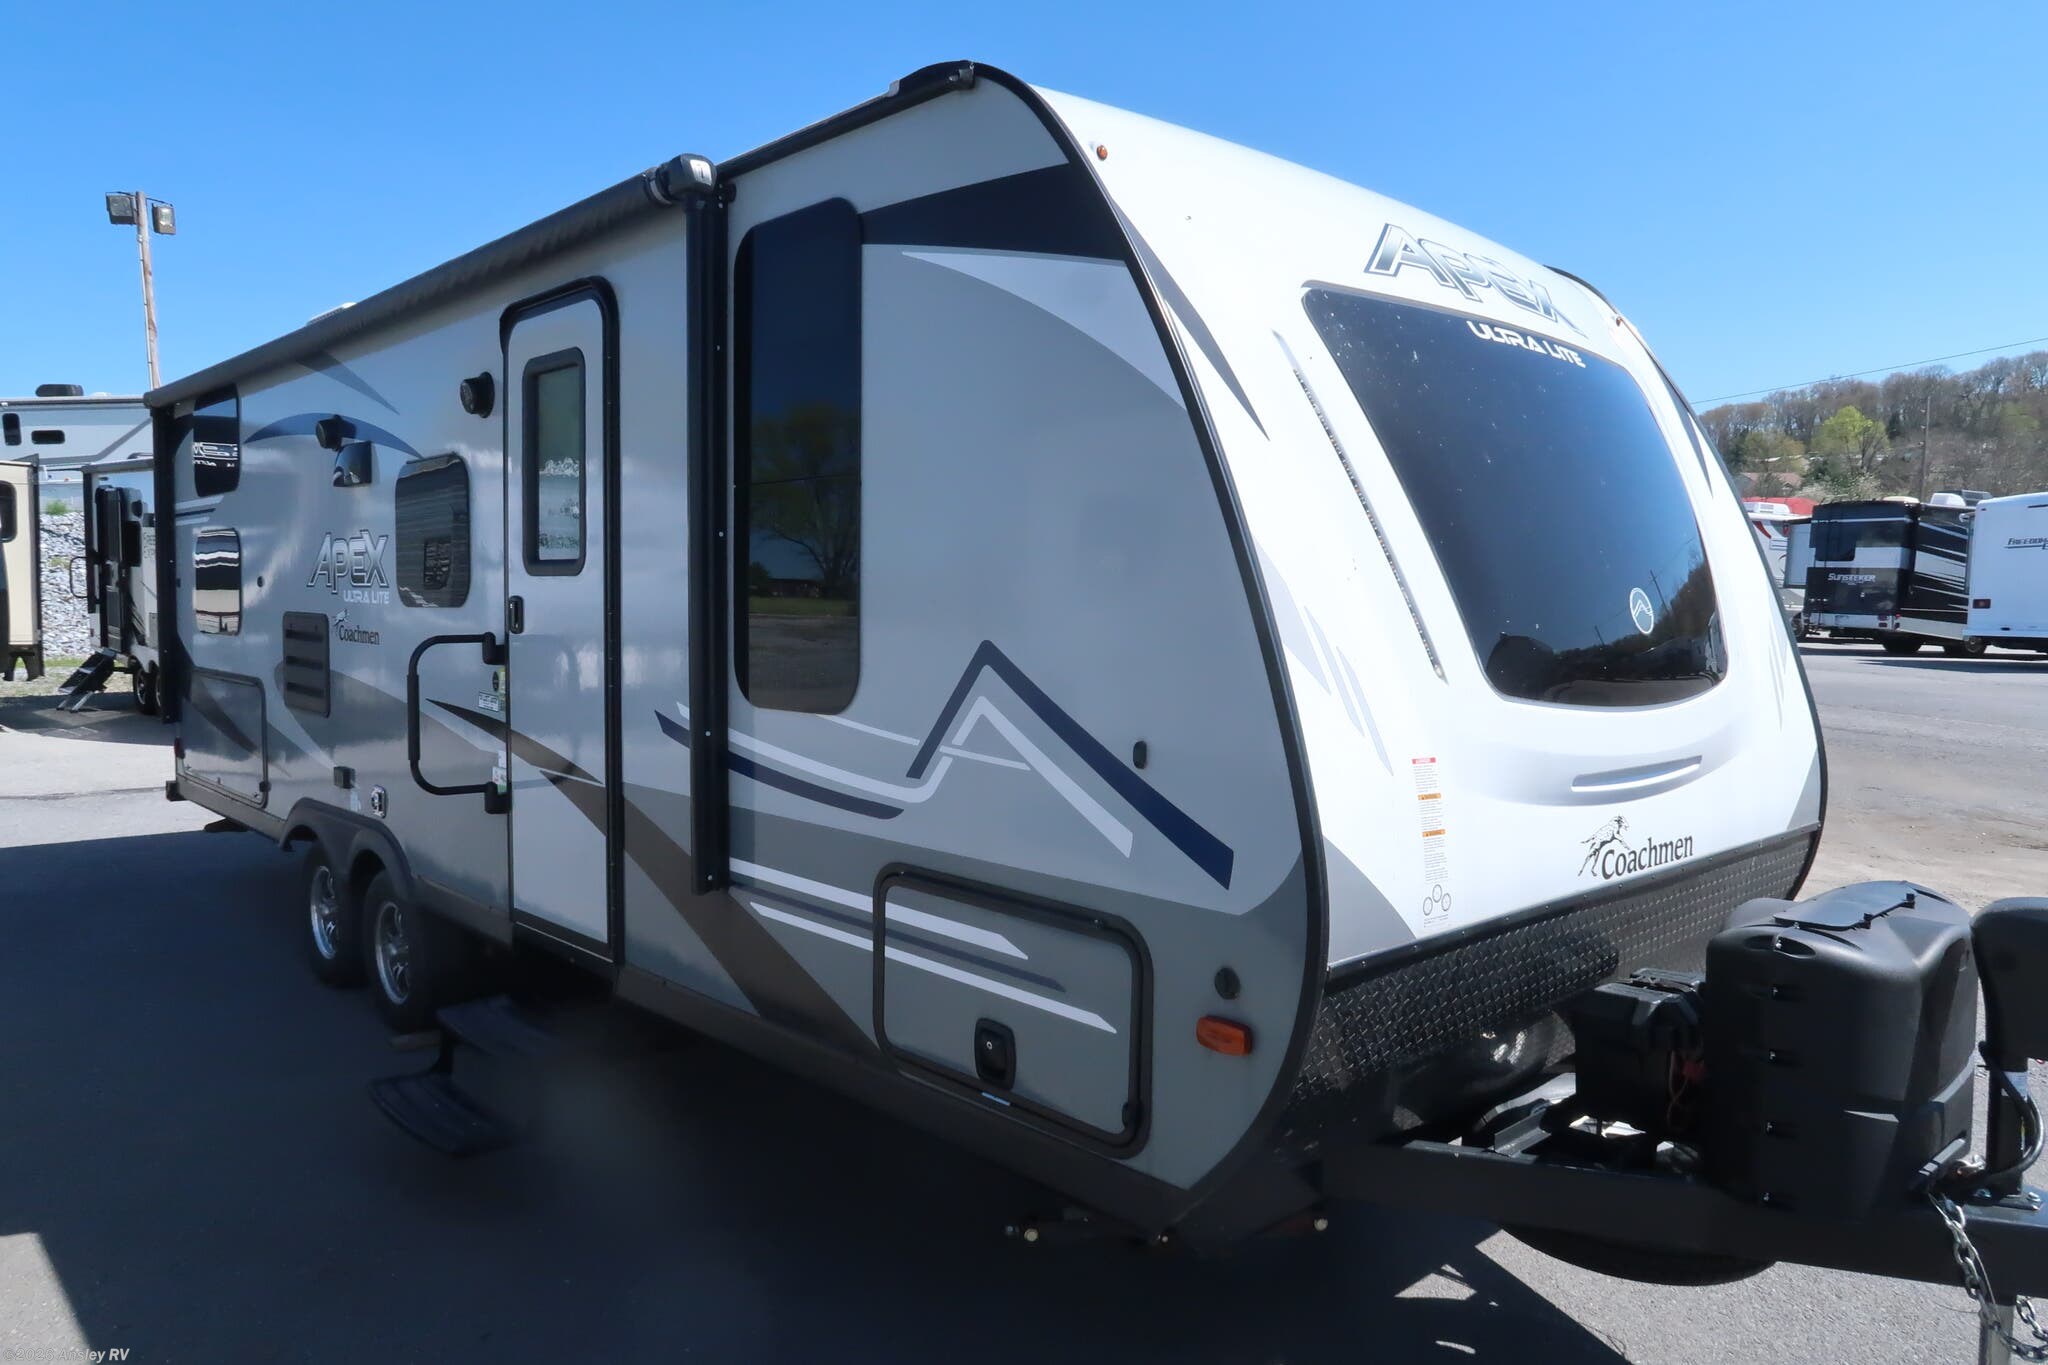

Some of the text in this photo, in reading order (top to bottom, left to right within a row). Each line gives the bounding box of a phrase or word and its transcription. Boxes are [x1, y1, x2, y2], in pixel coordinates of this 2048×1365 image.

[1363, 223, 1589, 339] APEX
[1466, 320, 1587, 369] ULTRA LITE
[306, 529, 389, 595] APEX
[343, 590, 390, 605] ULTRA LITE
[338, 624, 380, 646] Coachmen
[1601, 835, 1693, 880] Coachmen
